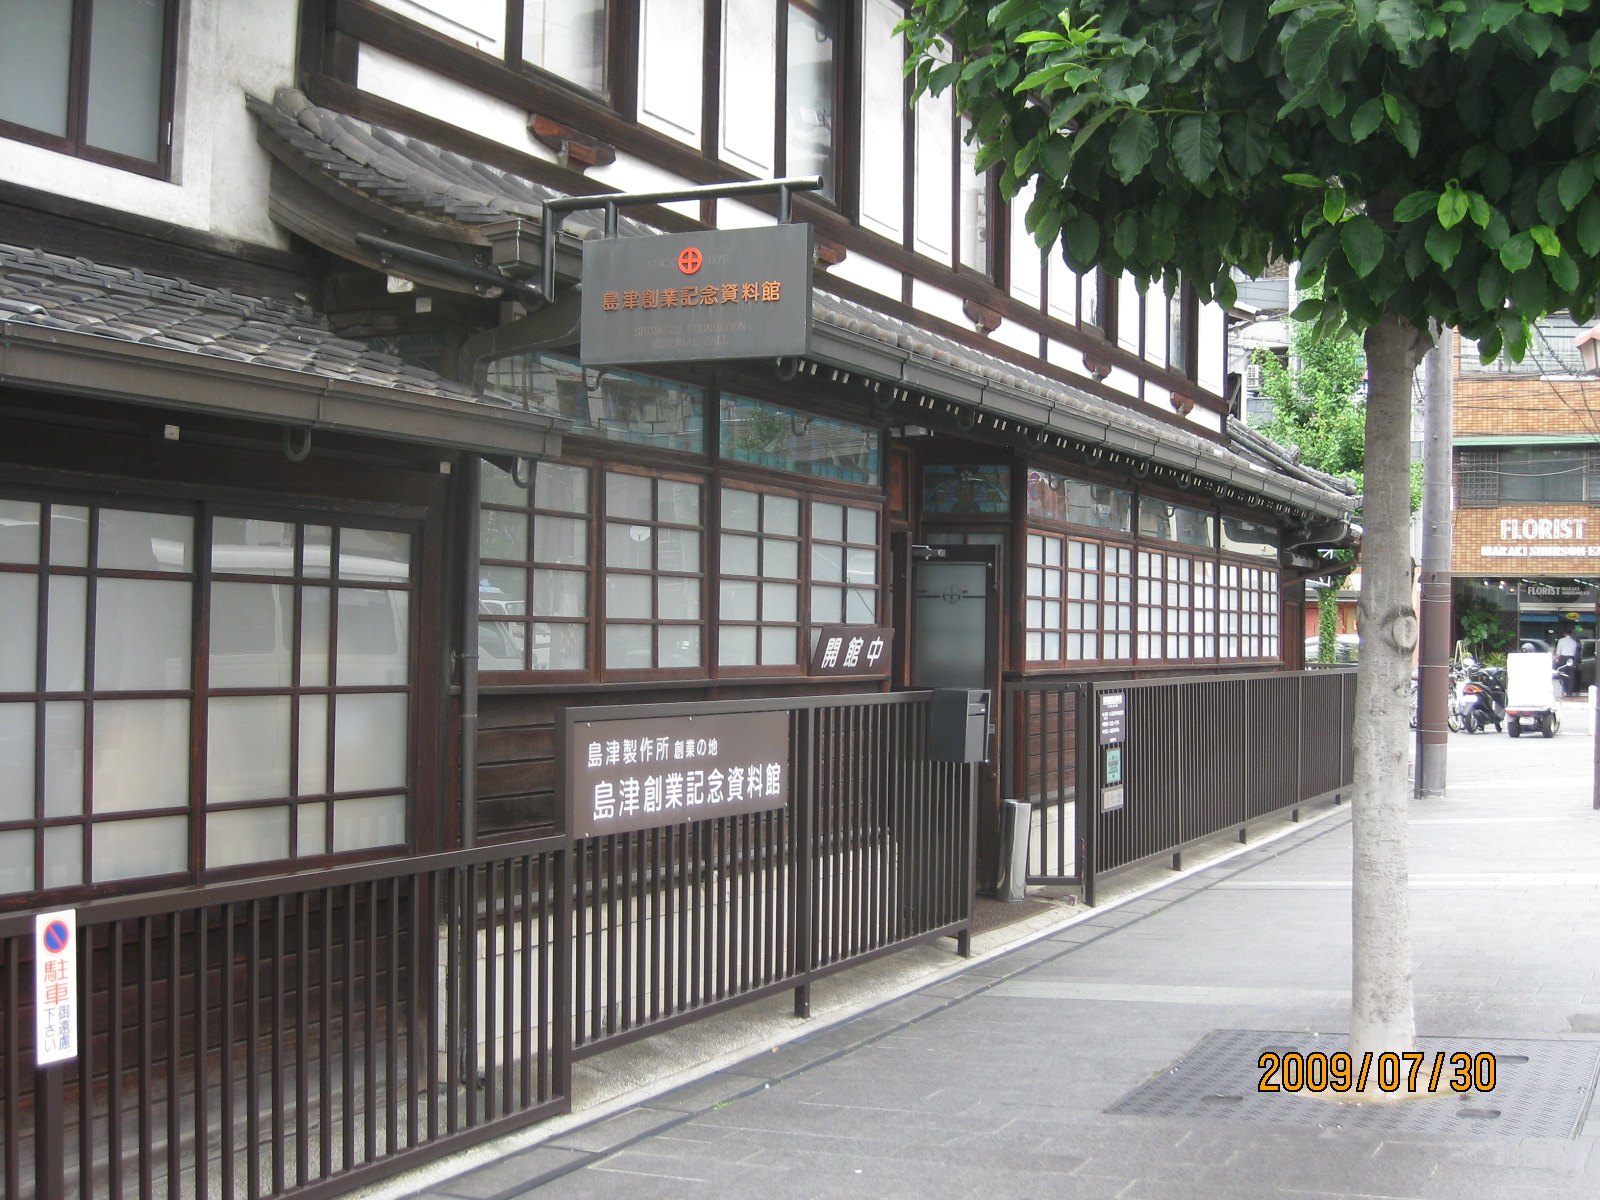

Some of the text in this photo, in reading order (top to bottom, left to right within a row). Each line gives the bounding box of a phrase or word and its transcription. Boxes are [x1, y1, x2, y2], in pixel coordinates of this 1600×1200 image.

[707, 254, 729, 265] 1875
[602, 280, 782, 312] 島津創業記念資料館
[687, 321, 746, 334] FOUNDATION
[704, 334, 729, 346] HALL
[1500, 518, 1586, 540] FLORIST
[1527, 586, 1561, 596] FLORIST
[821, 635, 884, 669] 開館中
[587, 736, 718, 768] 島津製作所 創業の地
[593, 762, 781, 821] 島津創業記念資料館
[43, 958, 70, 1006] 駐車
[44, 1007, 57, 1053] 下さい
[58, 1004, 71, 1051] 御遠慮
